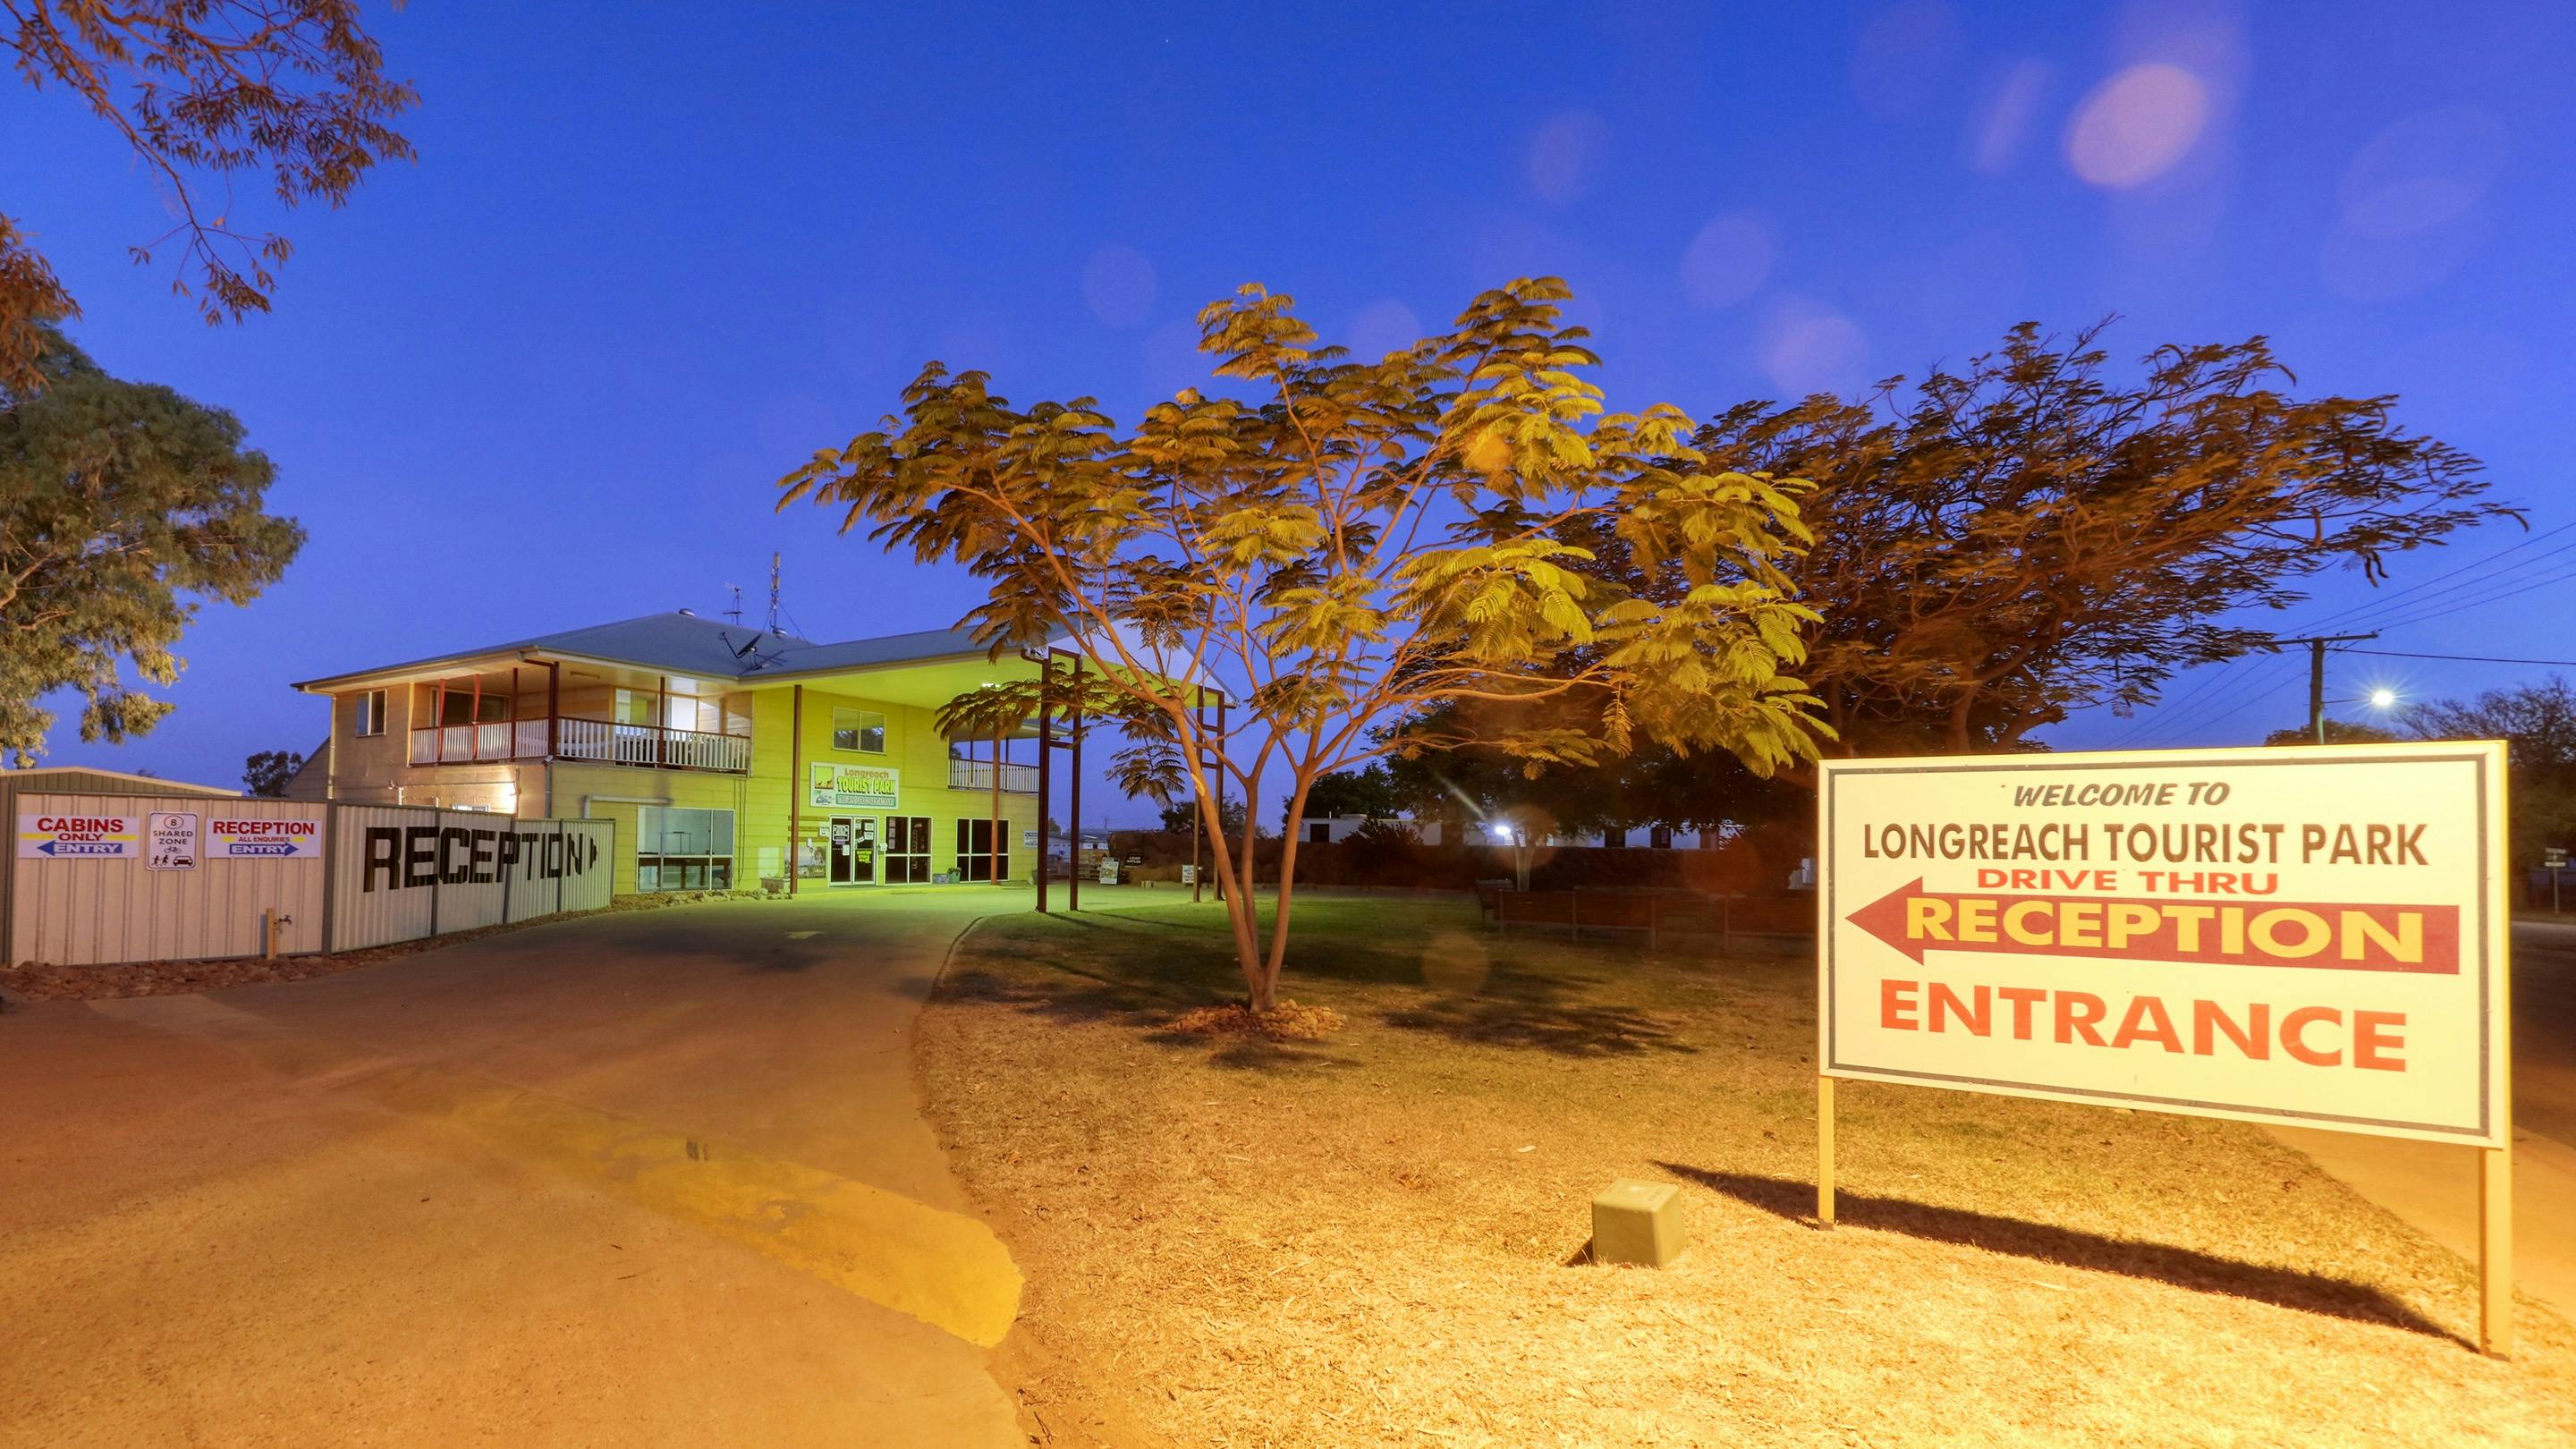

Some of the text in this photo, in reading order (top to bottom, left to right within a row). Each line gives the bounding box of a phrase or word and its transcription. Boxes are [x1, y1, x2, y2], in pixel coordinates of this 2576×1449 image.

[844, 768, 889, 779] Longreach
[837, 775, 895, 796] TOURIST PARK
[2013, 782, 2231, 808] WELCOME TO
[38, 818, 124, 833] CABINS
[213, 821, 315, 835] RECEPTION
[54, 843, 119, 853] ENTRY
[58, 833, 104, 842] ONLY
[1864, 822, 2429, 866] LONGREACH TOURIST PARK
[231, 844, 289, 853] ENTRY
[363, 826, 583, 893] RECEPTION
[1978, 869, 2278, 895] DRIVE THRU
[1906, 896, 2424, 963] RECEPTION
[1880, 979, 2407, 1073] ENTRANCE
